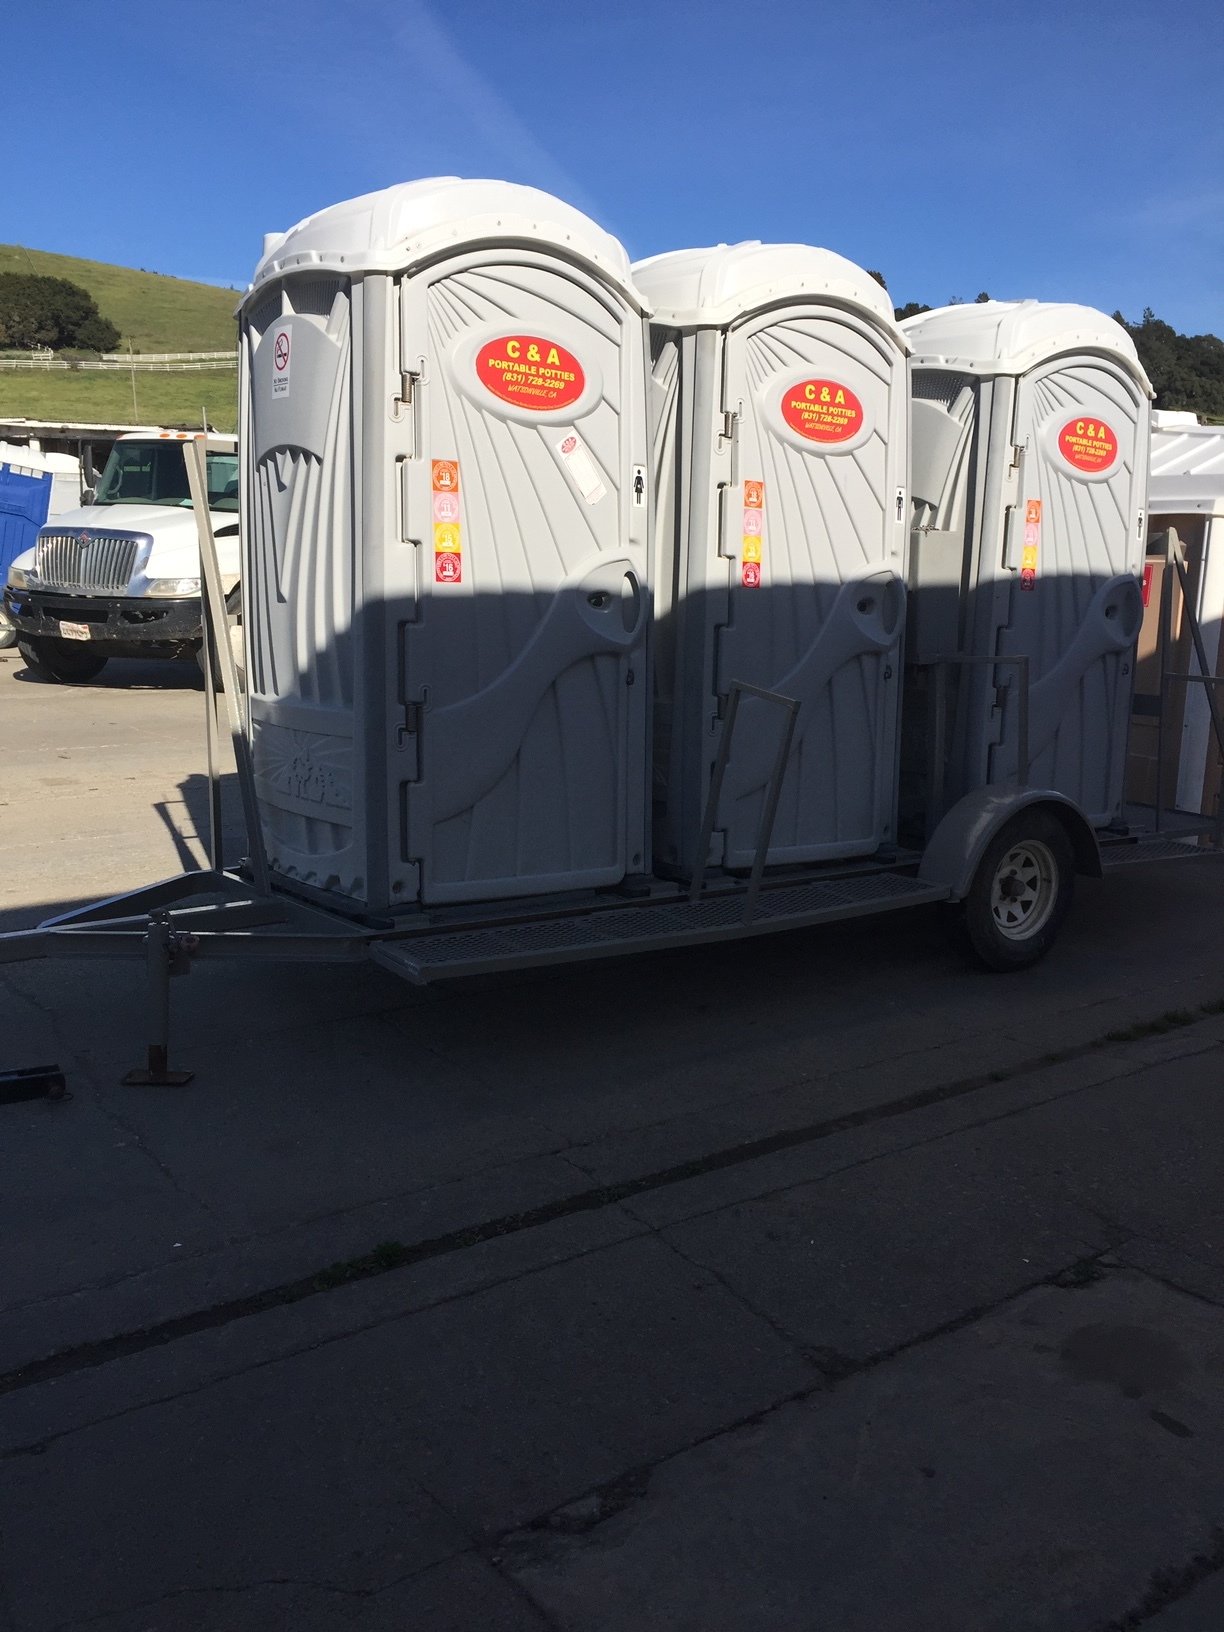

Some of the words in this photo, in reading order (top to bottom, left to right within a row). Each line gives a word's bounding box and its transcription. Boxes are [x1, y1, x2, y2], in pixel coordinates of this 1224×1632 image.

[506, 340, 520, 358] C
[527, 344, 541, 362] &
[546, 348, 560, 366] A
[488, 359, 537, 374] PORTABLE
[539, 366, 575, 381] POTTIES
[502, 372, 525, 384] (831)
[527, 376, 565, 389] 728-2269
[805, 384, 816, 400] C
[820, 386, 831, 402] &
[834, 389, 845, 405] A
[791, 400, 828, 413] PORTABLE
[828, 406, 856, 417] POTTIES
[1076, 421, 1084, 435] C
[1087, 423, 1095, 437] &
[1097, 426, 1105, 439] A
